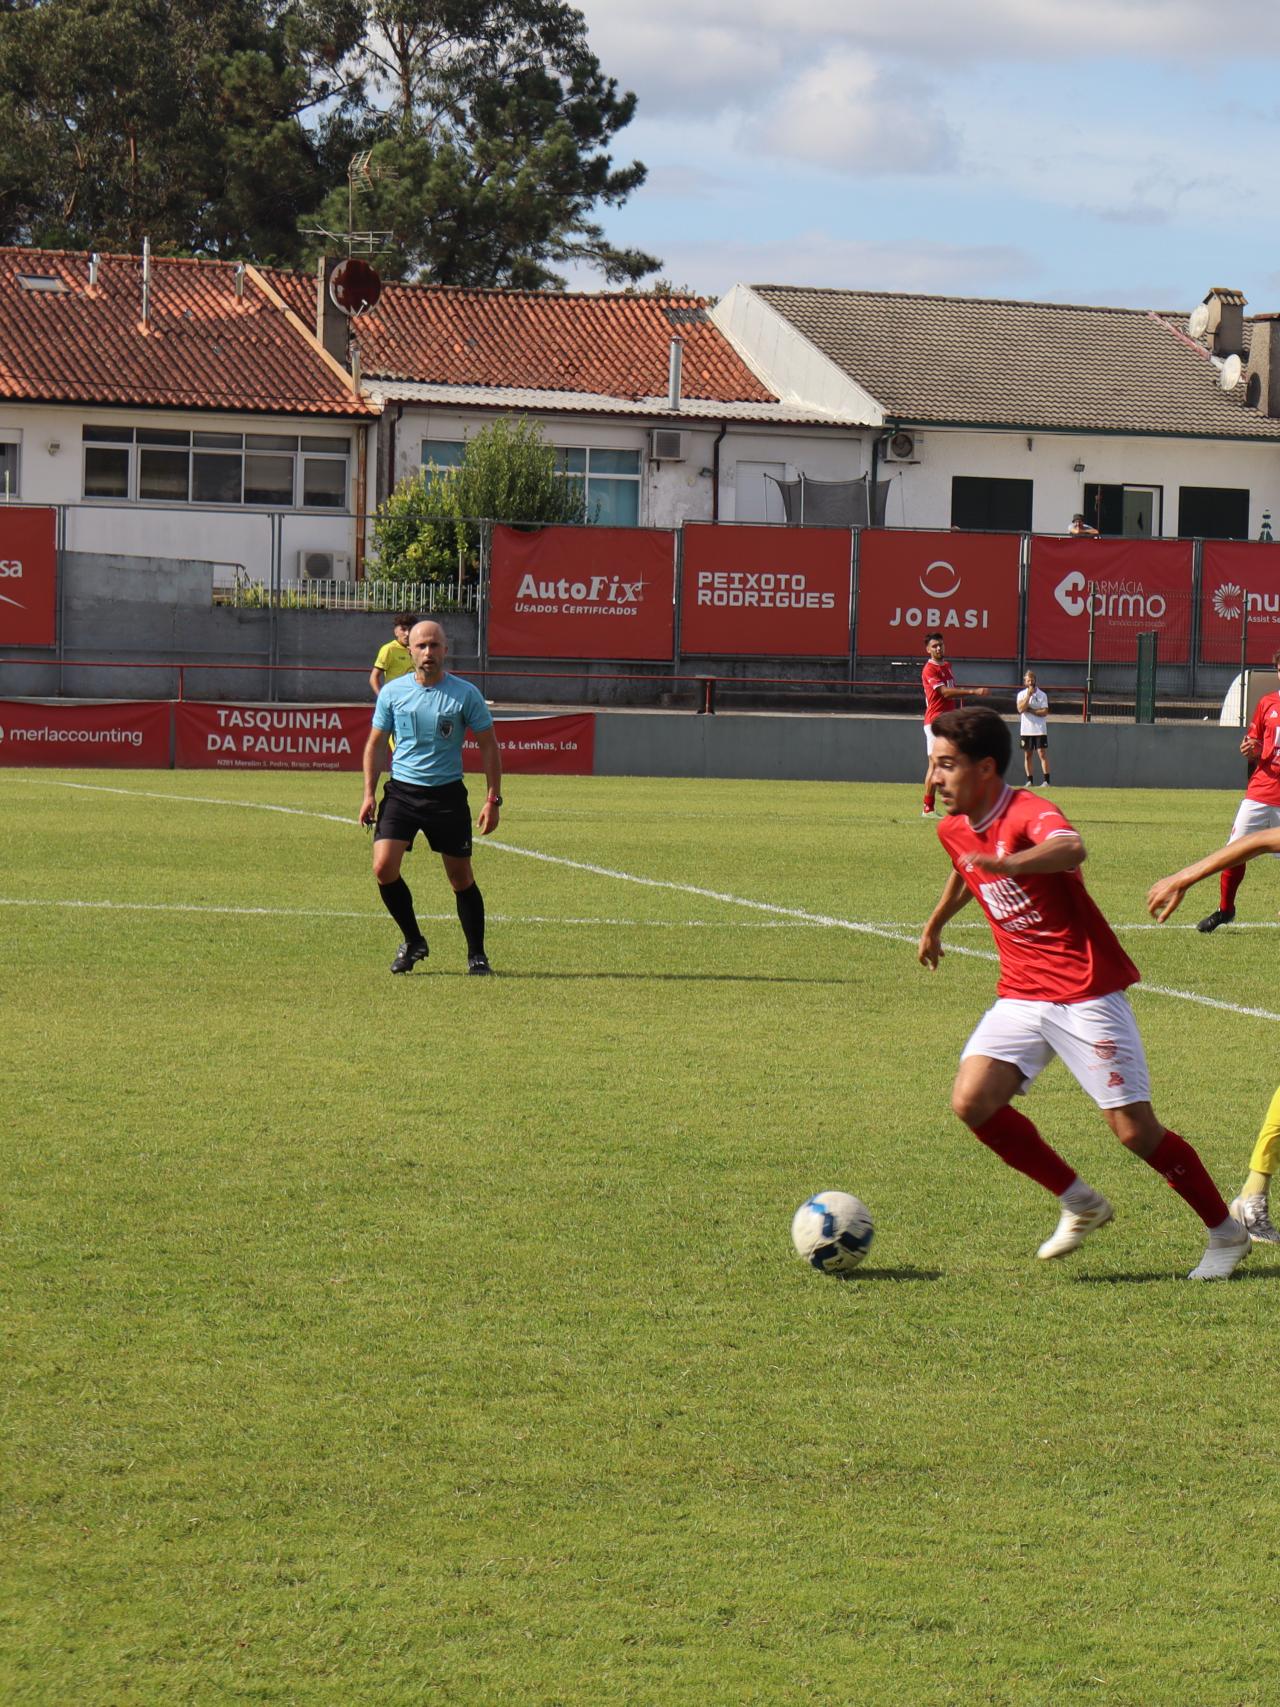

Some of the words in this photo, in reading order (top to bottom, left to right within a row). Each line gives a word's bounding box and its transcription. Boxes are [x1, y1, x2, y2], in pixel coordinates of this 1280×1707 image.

[516, 574, 641, 604] AutoFix
[698, 572, 806, 590] PEIXOTO
[1088, 578, 1144, 594] FARMÁCIA
[698, 590, 835, 608] RODRIGUES
[890, 608, 988, 628] JOBASI
[217, 710, 342, 731] TASQUINHA
[10, 726, 142, 746] merlaccounting
[207, 734, 236, 751] DA
[242, 735, 351, 754] PAULINHA
[508, 742, 516, 750] &
[519, 742, 557, 752] Lenhas,
[560, 742, 577, 750] Lda
